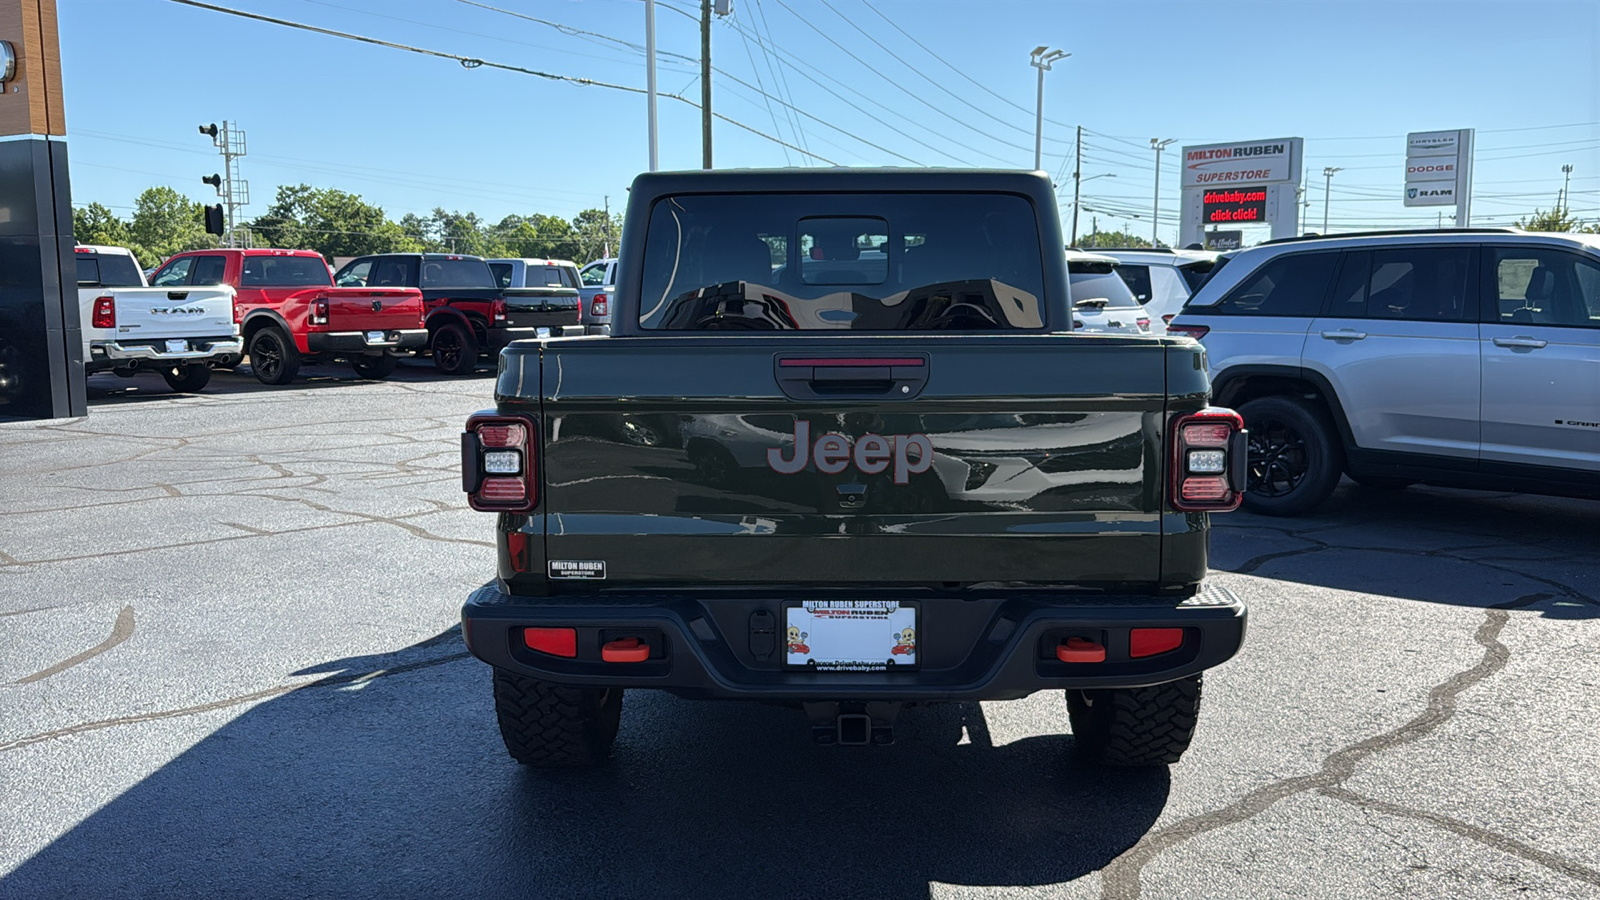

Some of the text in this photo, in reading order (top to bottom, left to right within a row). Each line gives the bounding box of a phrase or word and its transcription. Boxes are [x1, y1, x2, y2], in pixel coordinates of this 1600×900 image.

[1187, 144, 1284, 161] MILTON RUBEN
[1408, 165, 1454, 173] DODGE
[1196, 169, 1271, 183] SUPERSTORE
[1204, 190, 1266, 205] drivebaby.com
[1419, 189, 1453, 197] RAM
[1210, 207, 1257, 221] click click!
[150, 306, 206, 315] RAM
[767, 420, 934, 485] Jeep
[552, 562, 578, 570] MILTON
[830, 600, 853, 608] RUBEN
